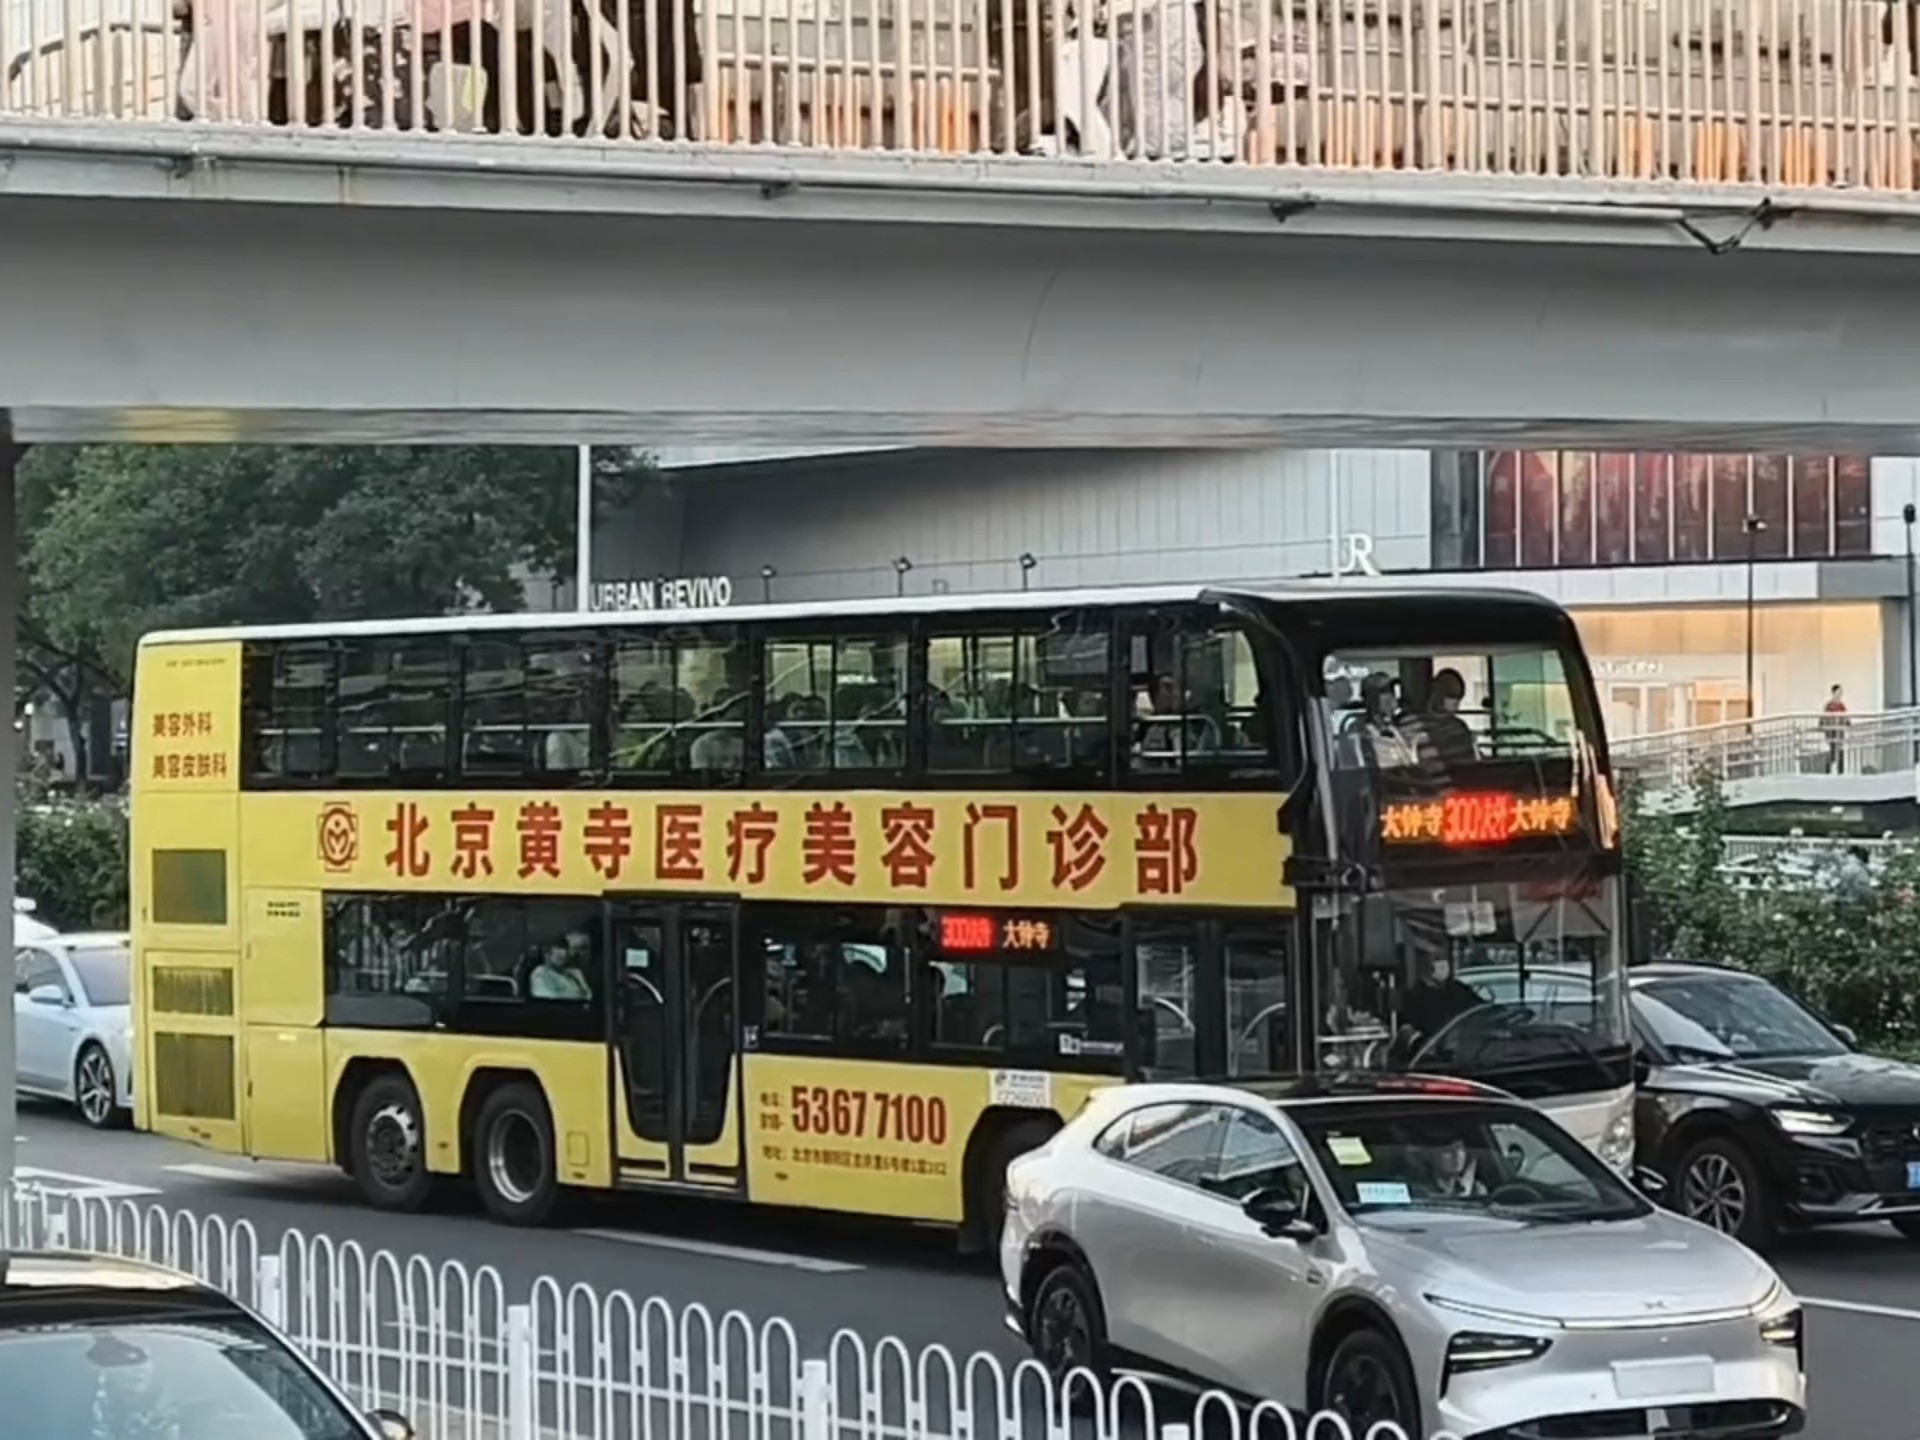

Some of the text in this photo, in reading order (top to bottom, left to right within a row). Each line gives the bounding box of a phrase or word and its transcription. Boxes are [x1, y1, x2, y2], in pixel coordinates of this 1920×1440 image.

[590, 576, 731, 611] URBAN REVIVO
[153, 711, 211, 737] 美容外科
[153, 752, 227, 779] 美容皮肤科
[385, 801, 1199, 894] 北京黄寺医疗美容门诊部
